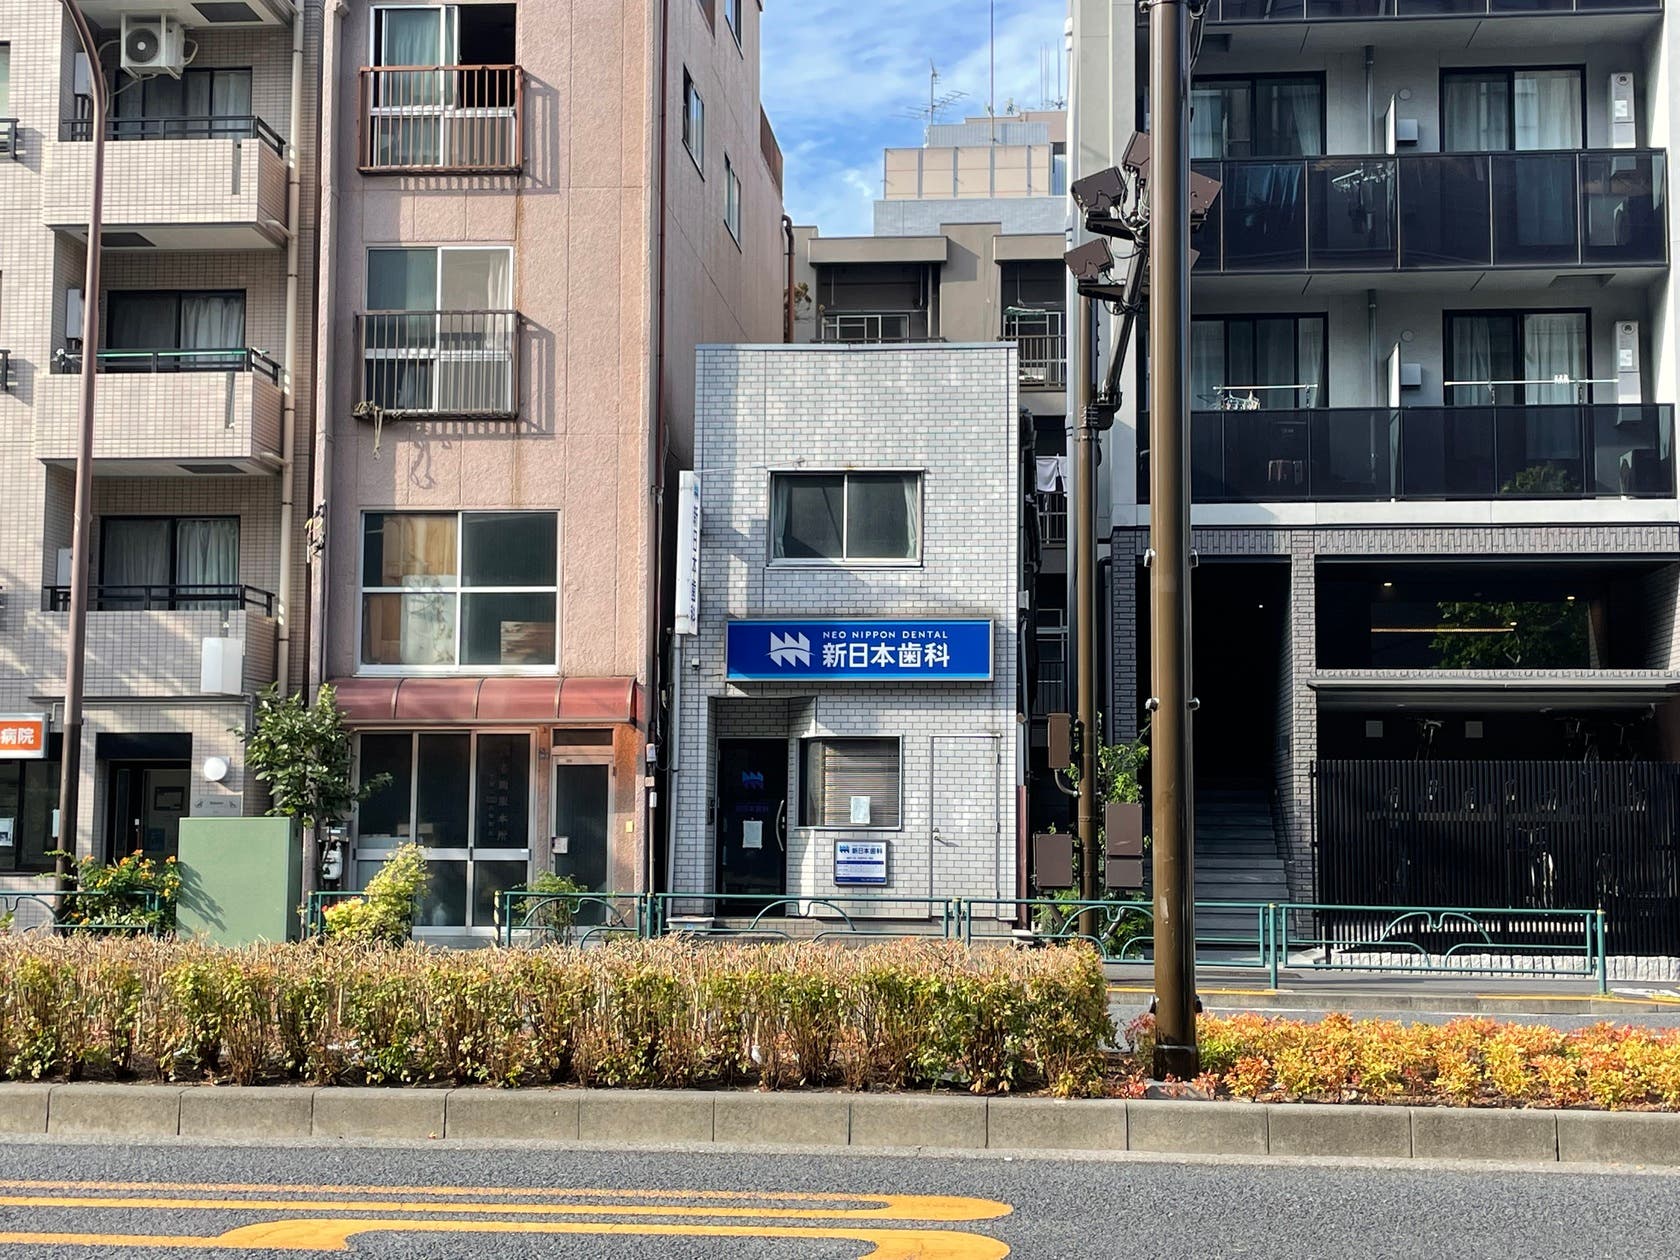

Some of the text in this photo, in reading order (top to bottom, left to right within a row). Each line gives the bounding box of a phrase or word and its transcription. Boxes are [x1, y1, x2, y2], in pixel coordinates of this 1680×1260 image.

[822, 630, 948, 639] NEO NIPPON DENTAL
[822, 642, 950, 668] 新日本歯科
[0, 727, 35, 745] 病院
